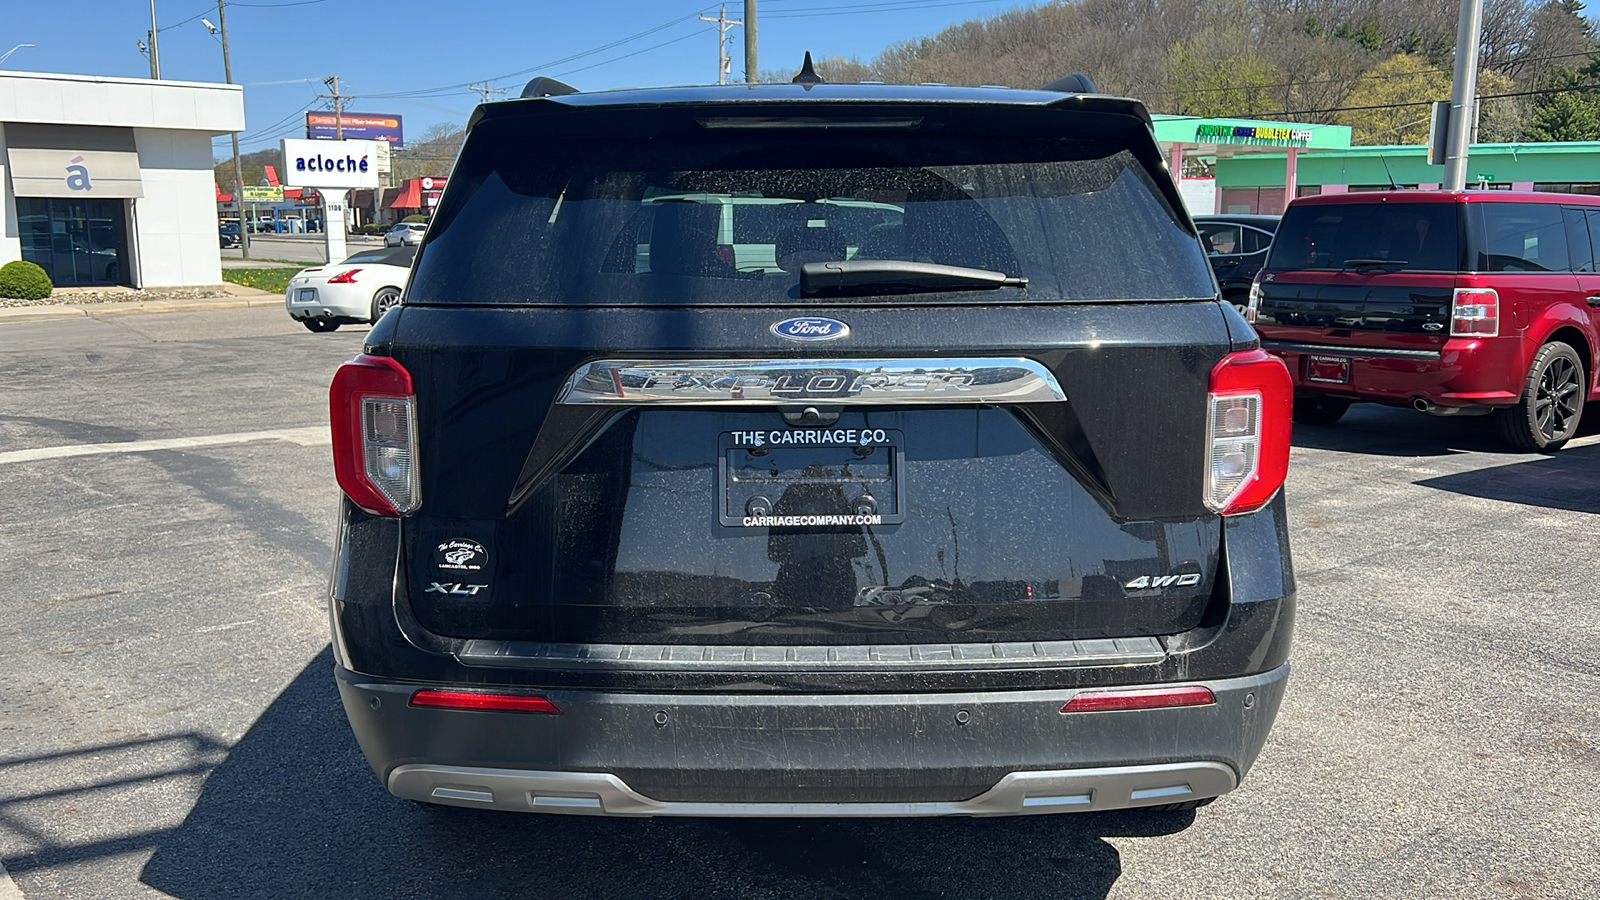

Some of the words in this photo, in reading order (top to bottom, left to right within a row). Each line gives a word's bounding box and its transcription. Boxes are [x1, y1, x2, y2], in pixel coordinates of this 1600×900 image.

[296, 154, 368, 172] acloché
[789, 320, 832, 334] Ford
[641, 374, 975, 393] EXPLORER
[732, 431, 766, 445] THE
[770, 430, 856, 444] CARRIAGE
[861, 429, 890, 444] CO.
[743, 515, 881, 526] CARRIAGECOMPANY.COM
[449, 540, 474, 550] Carriage
[1126, 573, 1200, 588] 4WD
[424, 582, 488, 594] XLT
